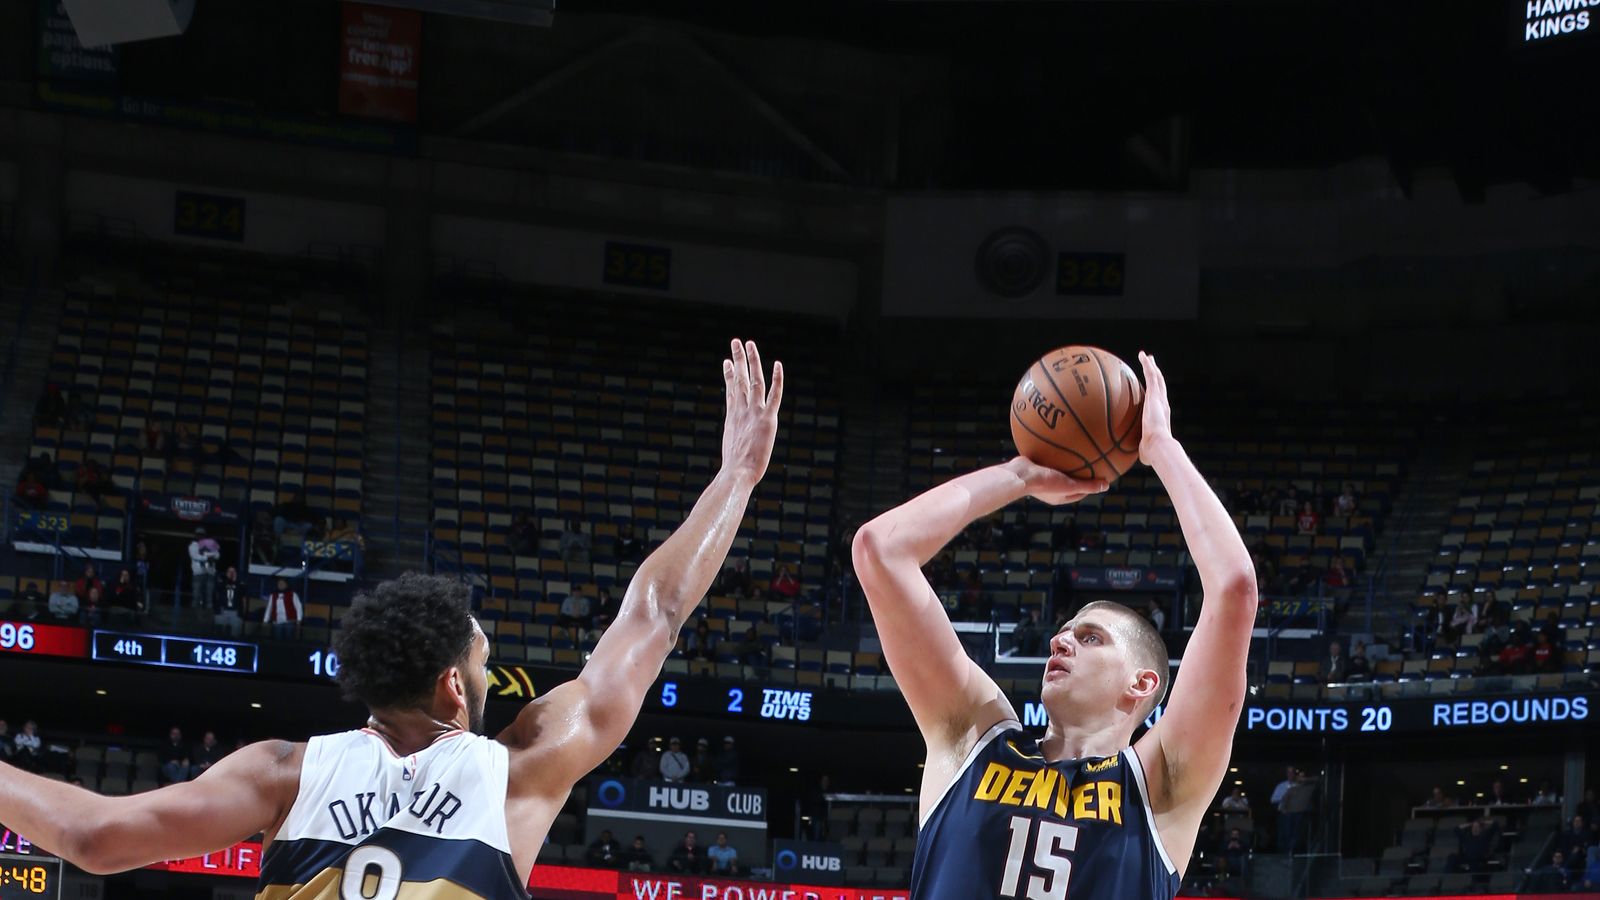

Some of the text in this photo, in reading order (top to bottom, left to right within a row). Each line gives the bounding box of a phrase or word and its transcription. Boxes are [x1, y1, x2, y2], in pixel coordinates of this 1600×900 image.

[1525, 11, 1590, 41] KINGS
[50, 51, 117, 72] options.
[176, 199, 241, 233] 324
[607, 249, 667, 282] 325
[1059, 259, 1121, 289] 326
[0, 624, 35, 650] 96
[113, 639, 238, 667] 4th 1:48
[661, 681, 678, 708] 5
[727, 688, 813, 713] 2 TIME
[760, 703, 812, 722] OUTS
[1247, 696, 1589, 732] POINTS 20 REBOUNDS
[648, 785, 763, 816] HUB CLUB
[973, 761, 1124, 826] DENVER
[339, 843, 403, 900] 0
[801, 852, 842, 873] HUB
[999, 815, 1080, 900] 15
[0, 865, 48, 894] :48
[631, 878, 683, 900] WE
